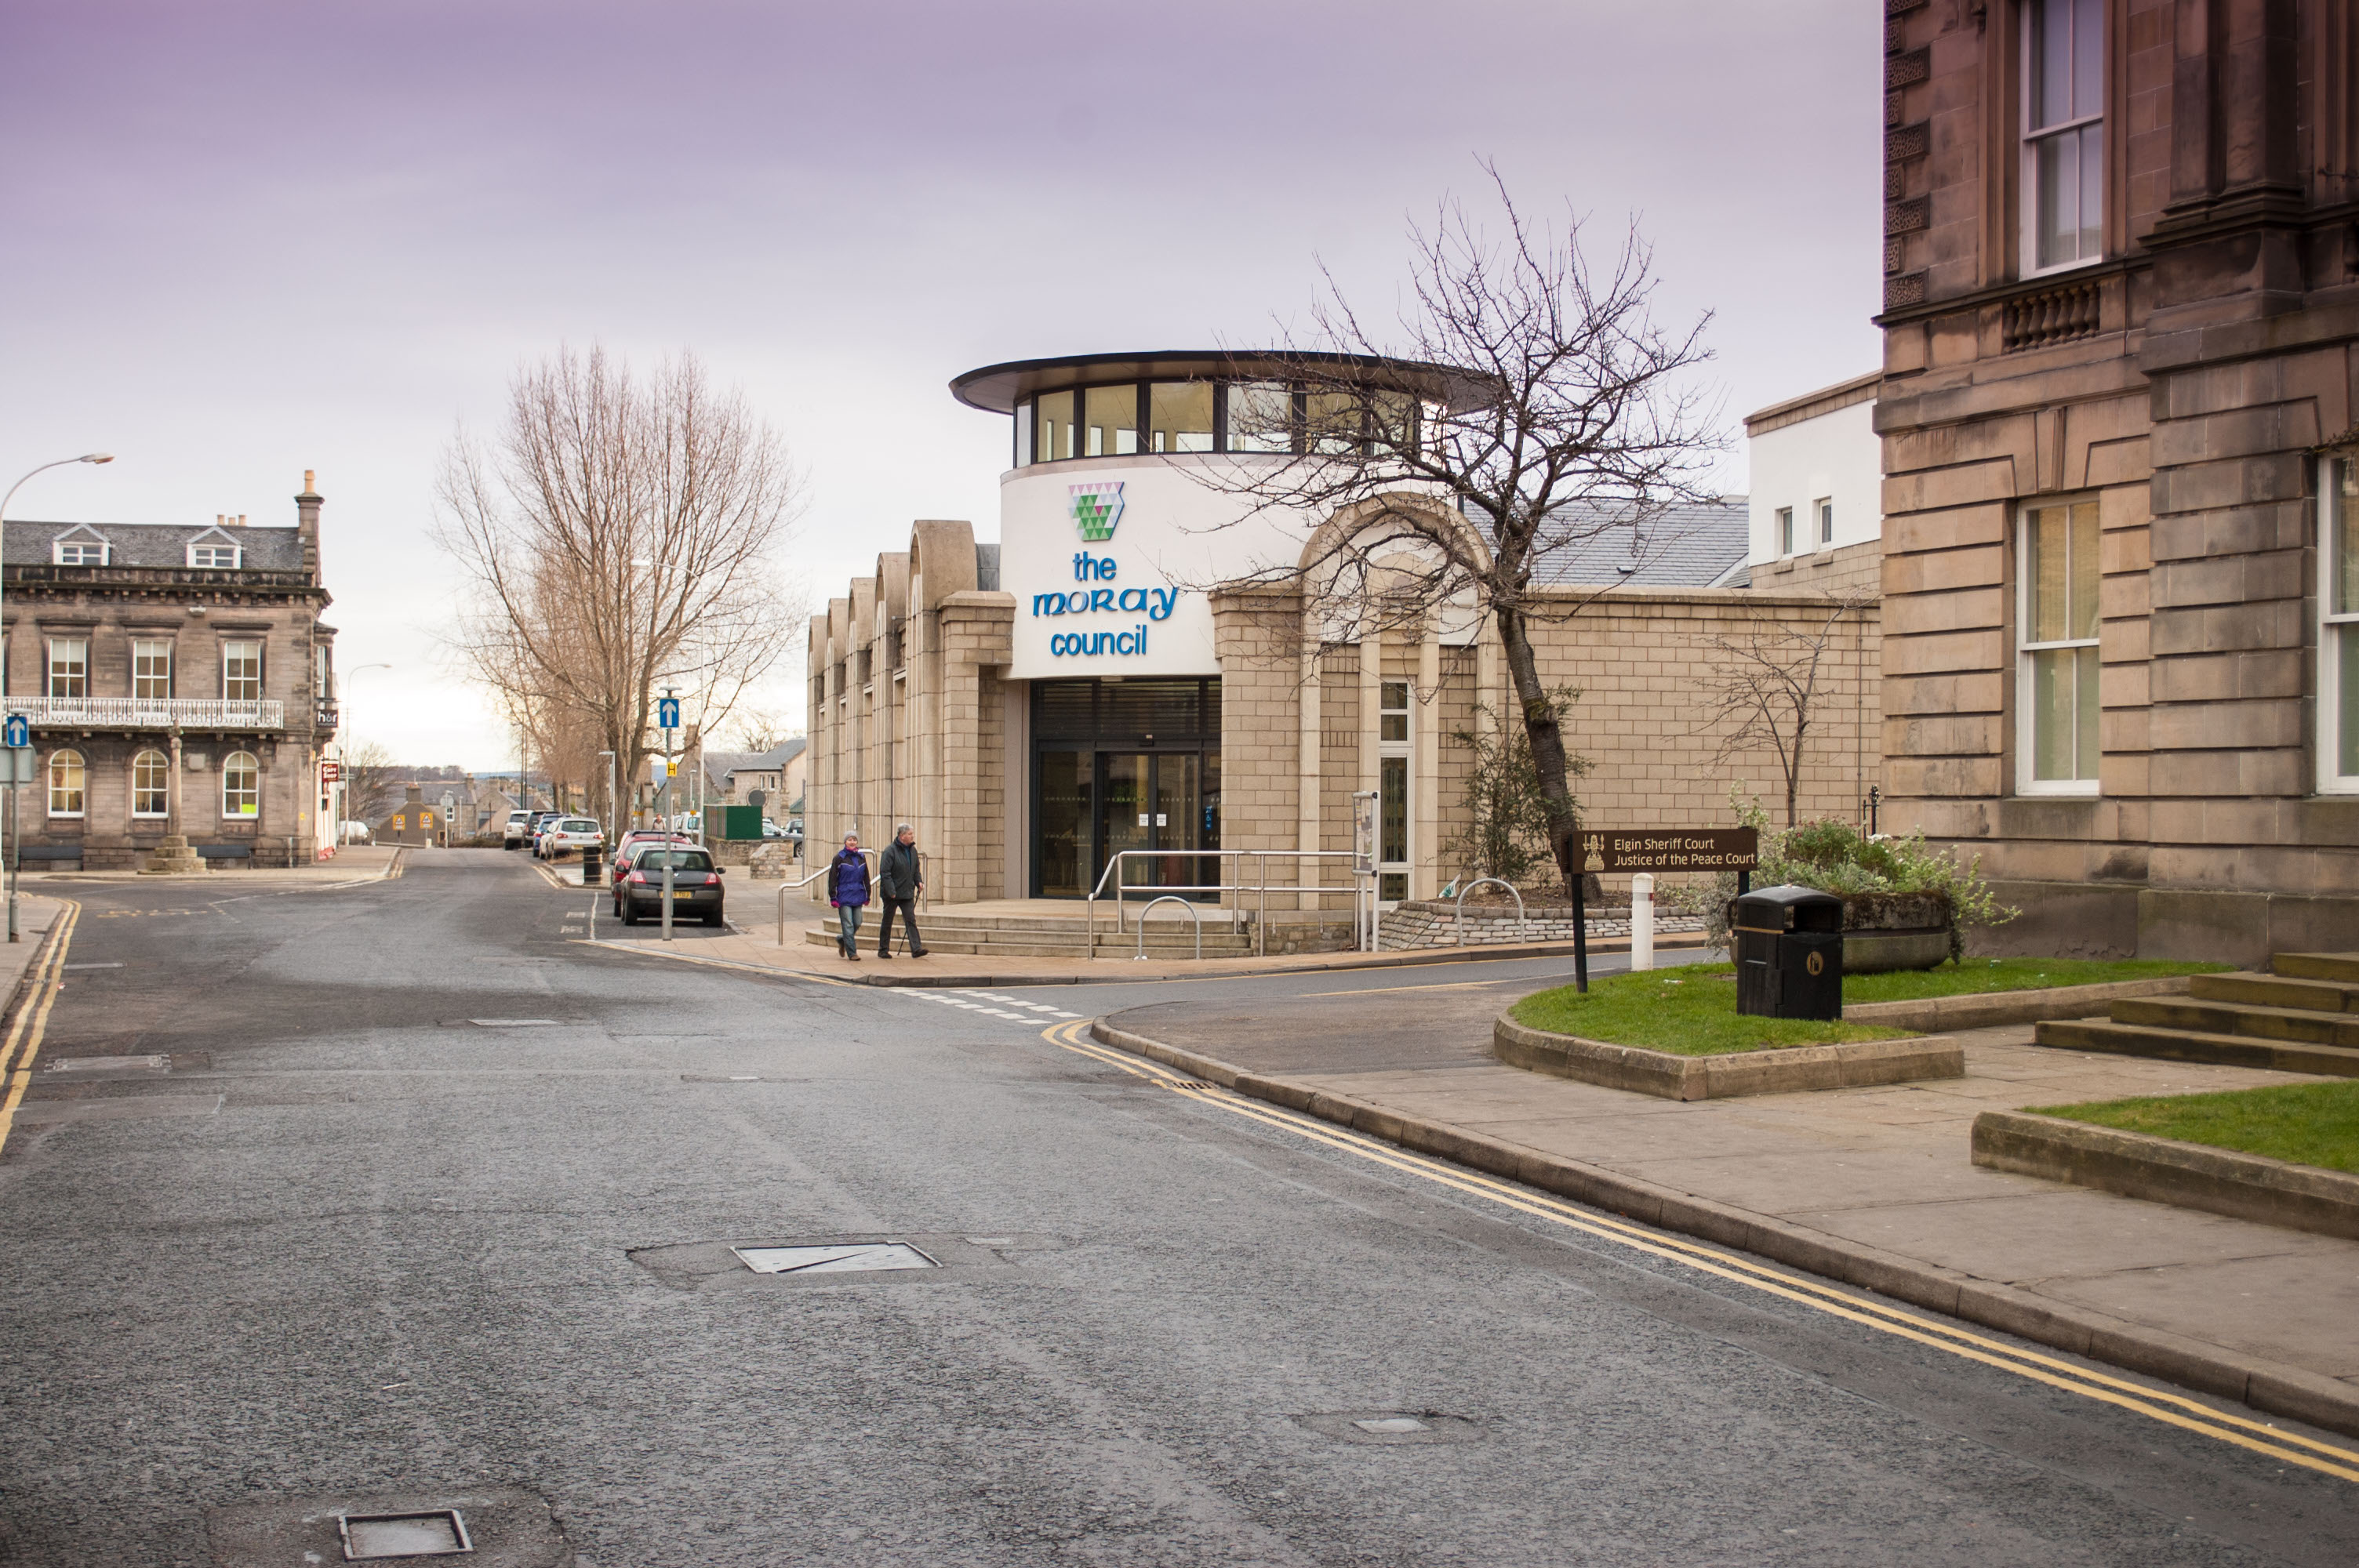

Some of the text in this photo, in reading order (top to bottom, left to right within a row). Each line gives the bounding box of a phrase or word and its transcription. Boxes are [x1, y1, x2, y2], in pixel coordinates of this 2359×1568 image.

[1073, 551, 1117, 582] the
[1051, 624, 1147, 655] council
[667, 764, 676, 775] H
[1615, 837, 1714, 852] Elgin Sheriff Court
[1614, 852, 1755, 866] Justice of the Peace Court
